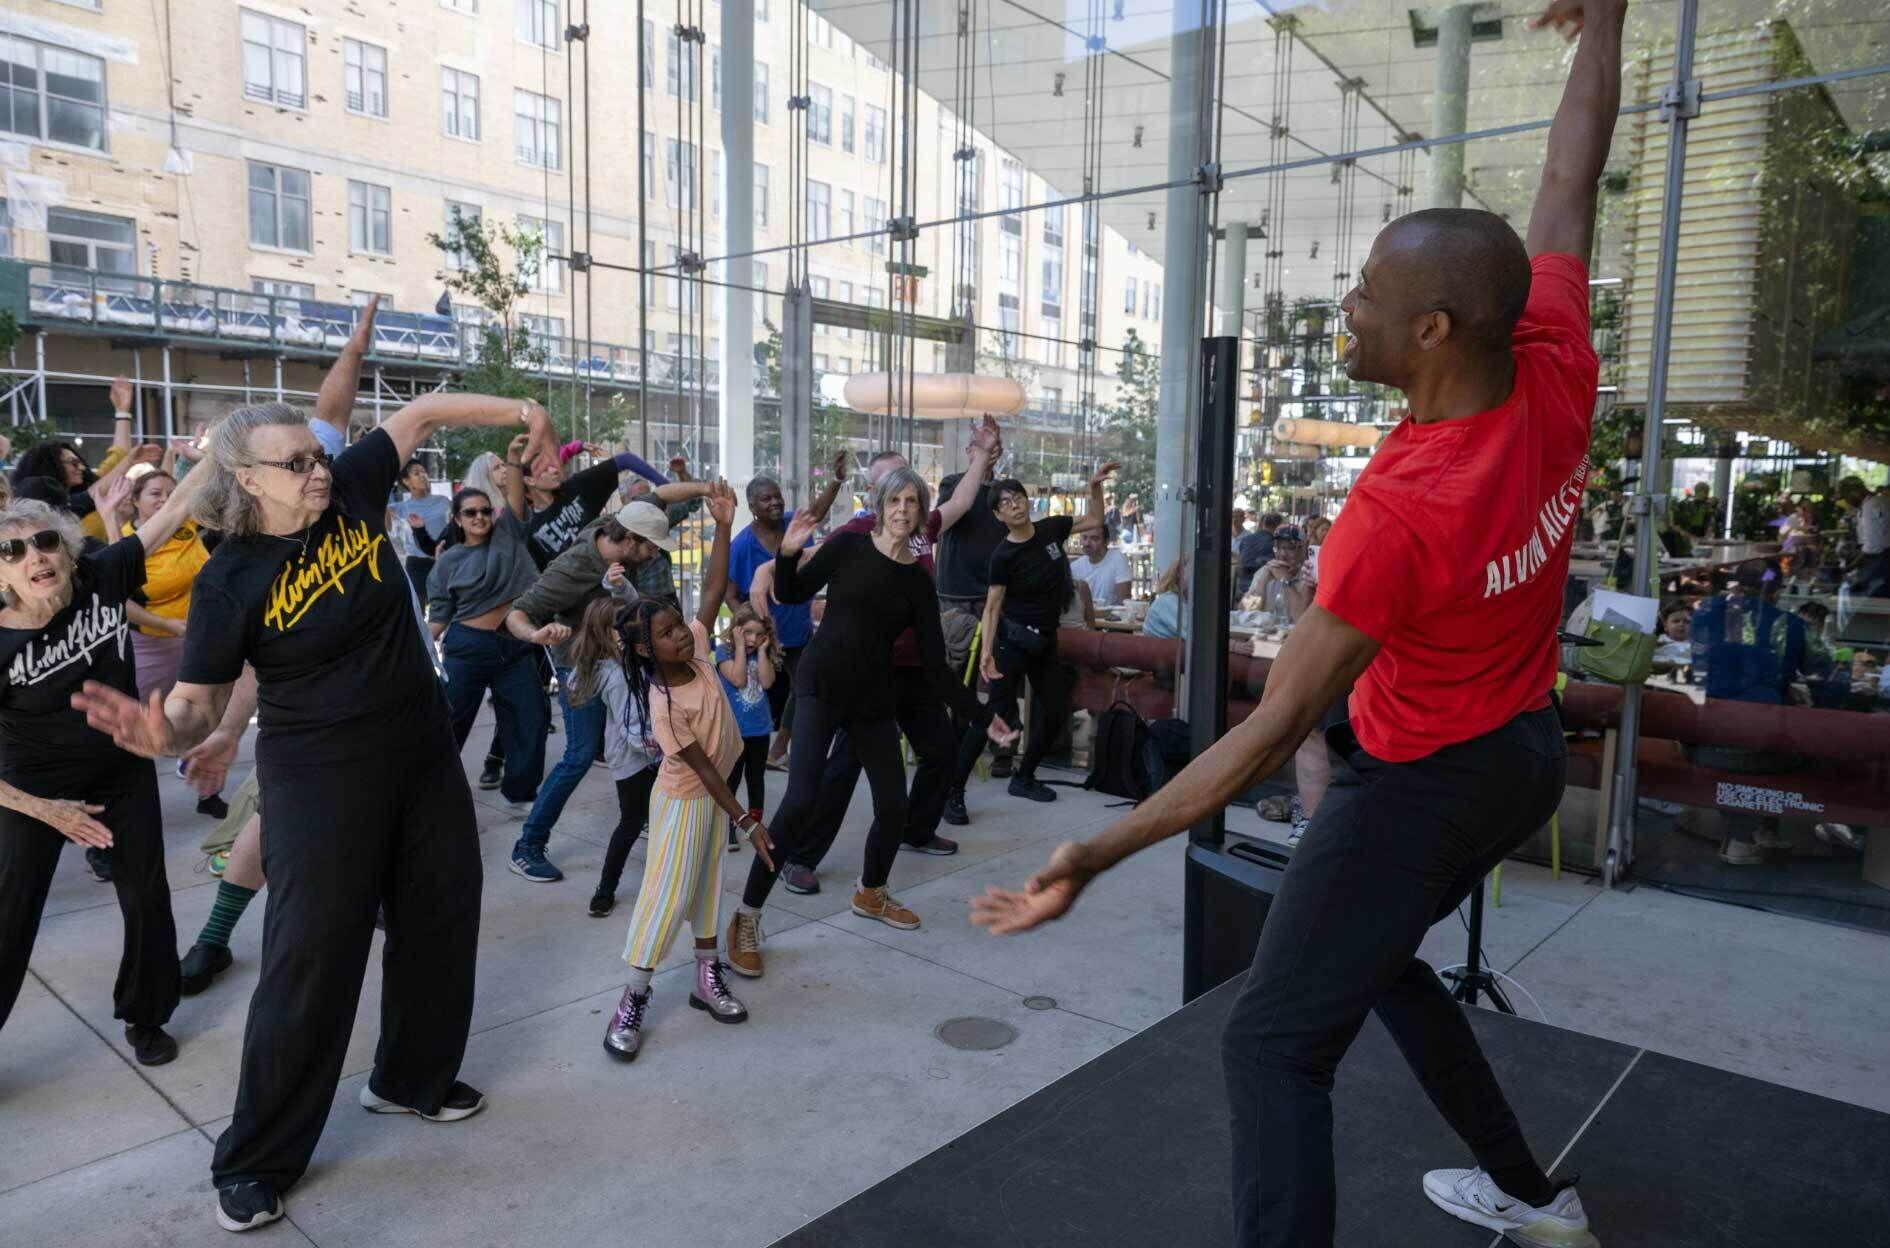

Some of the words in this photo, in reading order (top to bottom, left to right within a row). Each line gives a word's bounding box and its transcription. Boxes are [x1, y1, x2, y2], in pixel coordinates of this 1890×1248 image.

[1484, 526, 1548, 599] ALVIN
[1717, 782, 1733, 791] NO
[1734, 784, 1785, 799] SMOKING
[1786, 792, 1803, 801] OR
[1717, 789, 1738, 799] USE
[1739, 792, 1754, 801] OF
[1755, 794, 1825, 813] ELECTRONIC
[1716, 796, 1784, 814] CIGARETTES
